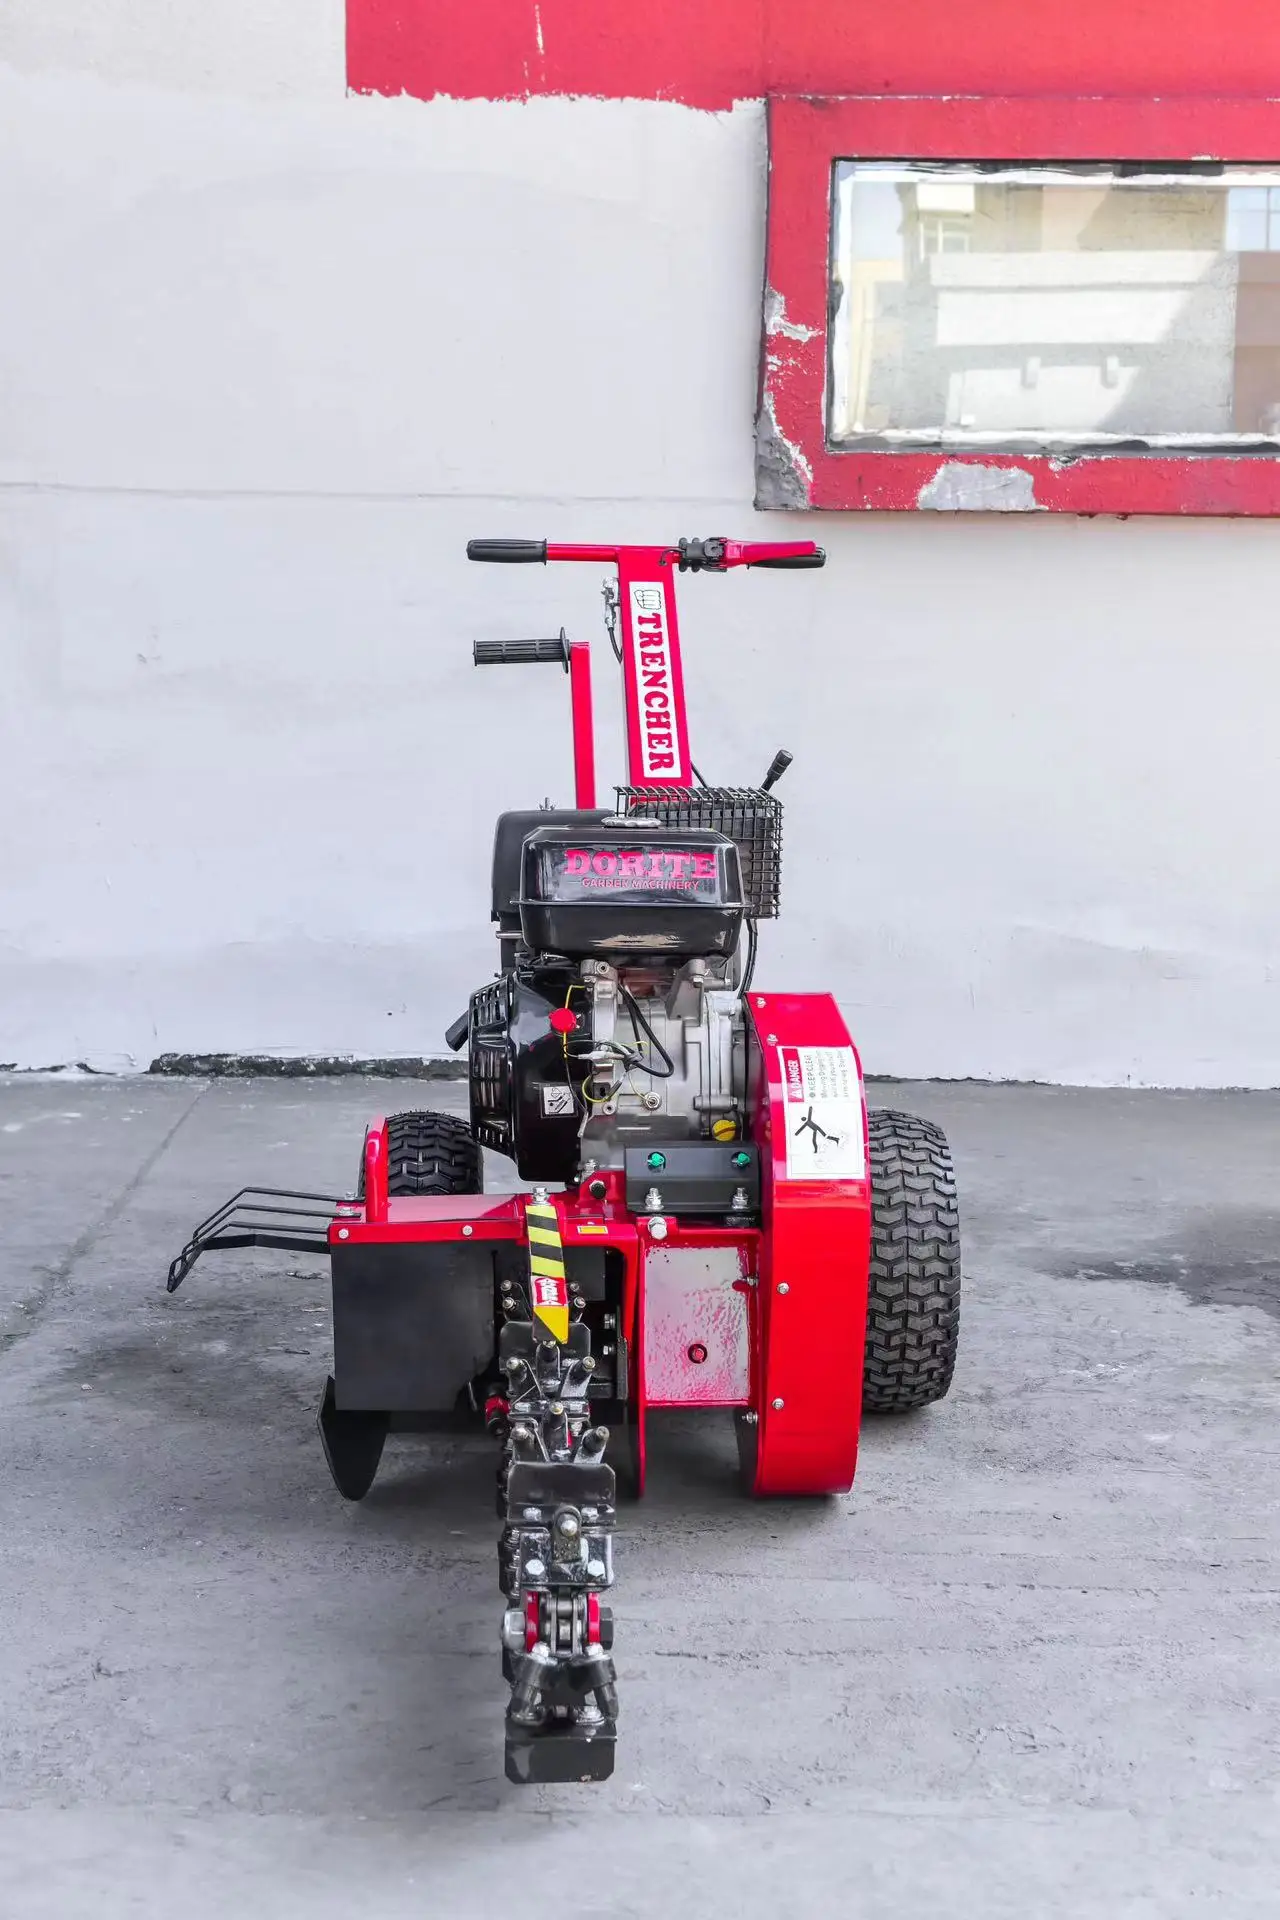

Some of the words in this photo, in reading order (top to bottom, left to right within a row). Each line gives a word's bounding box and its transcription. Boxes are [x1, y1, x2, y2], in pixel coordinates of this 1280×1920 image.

[638, 613, 674, 771] TRENCHER
[564, 849, 717, 878] DORITE
[582, 877, 629, 888] GARDEN
[631, 879, 699, 890] MACHINERY
[788, 1060, 800, 1088] DANGER
